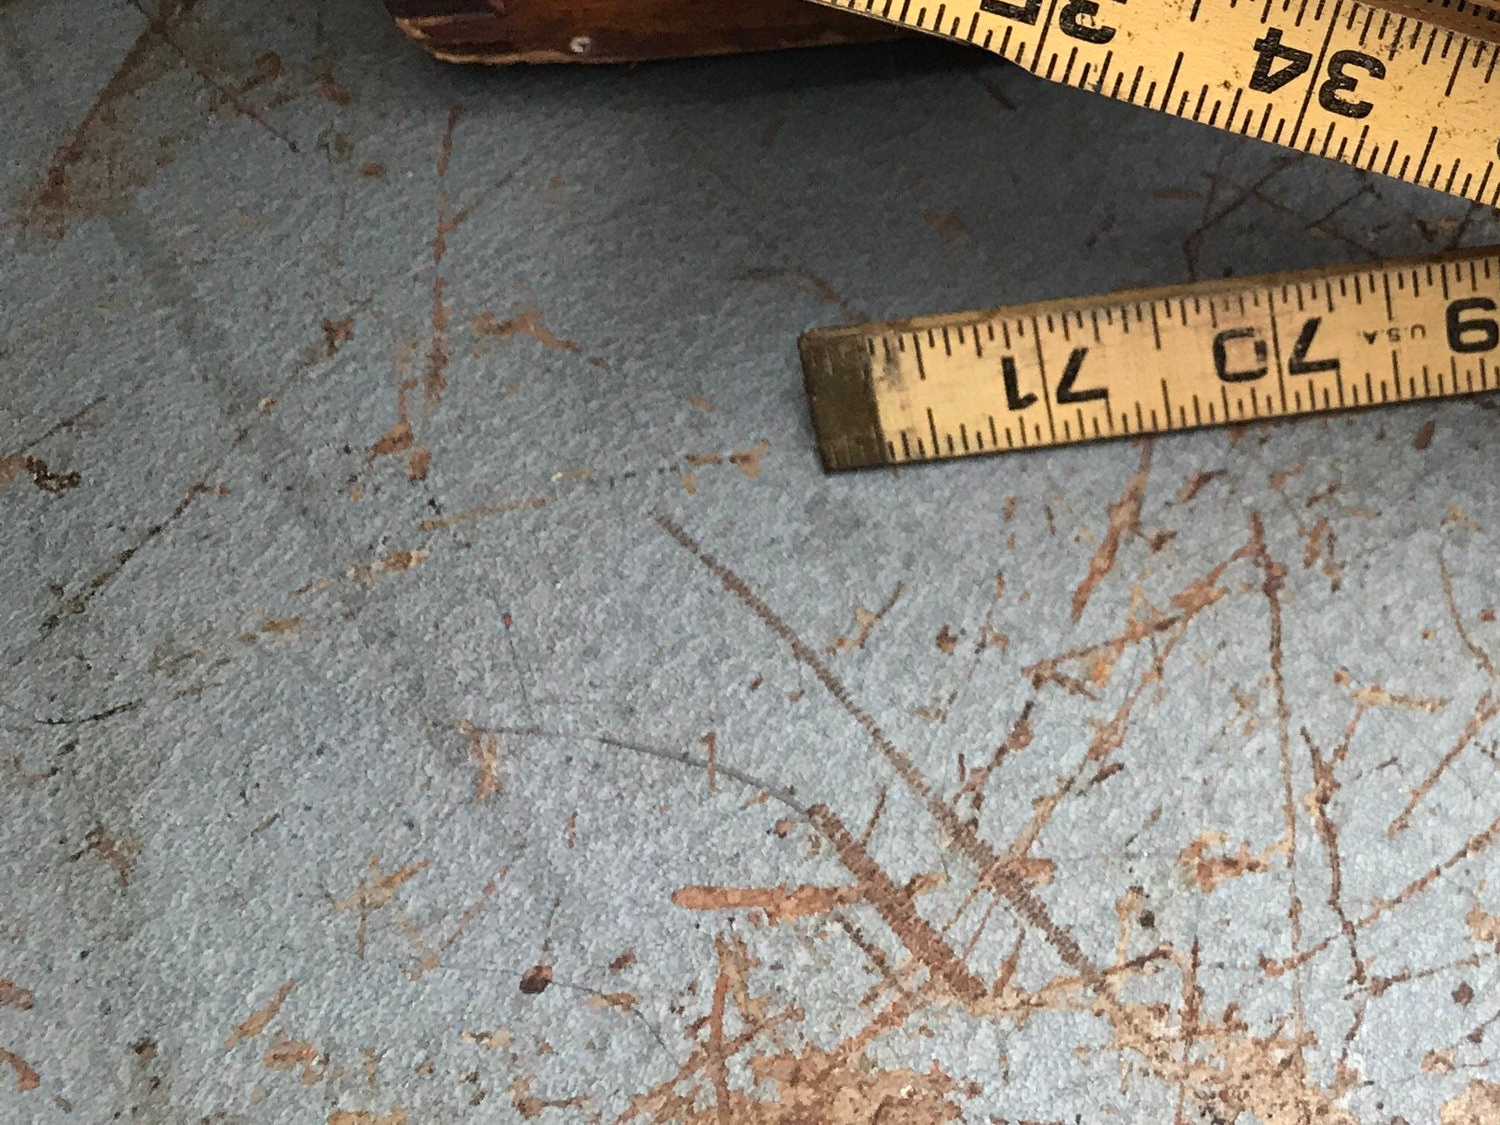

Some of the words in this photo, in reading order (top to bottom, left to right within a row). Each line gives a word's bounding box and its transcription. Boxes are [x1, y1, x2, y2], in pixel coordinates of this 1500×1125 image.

[1248, 26, 1387, 119] 34
[1000, 347, 1109, 412] 71
[1212, 316, 1341, 383] 70
